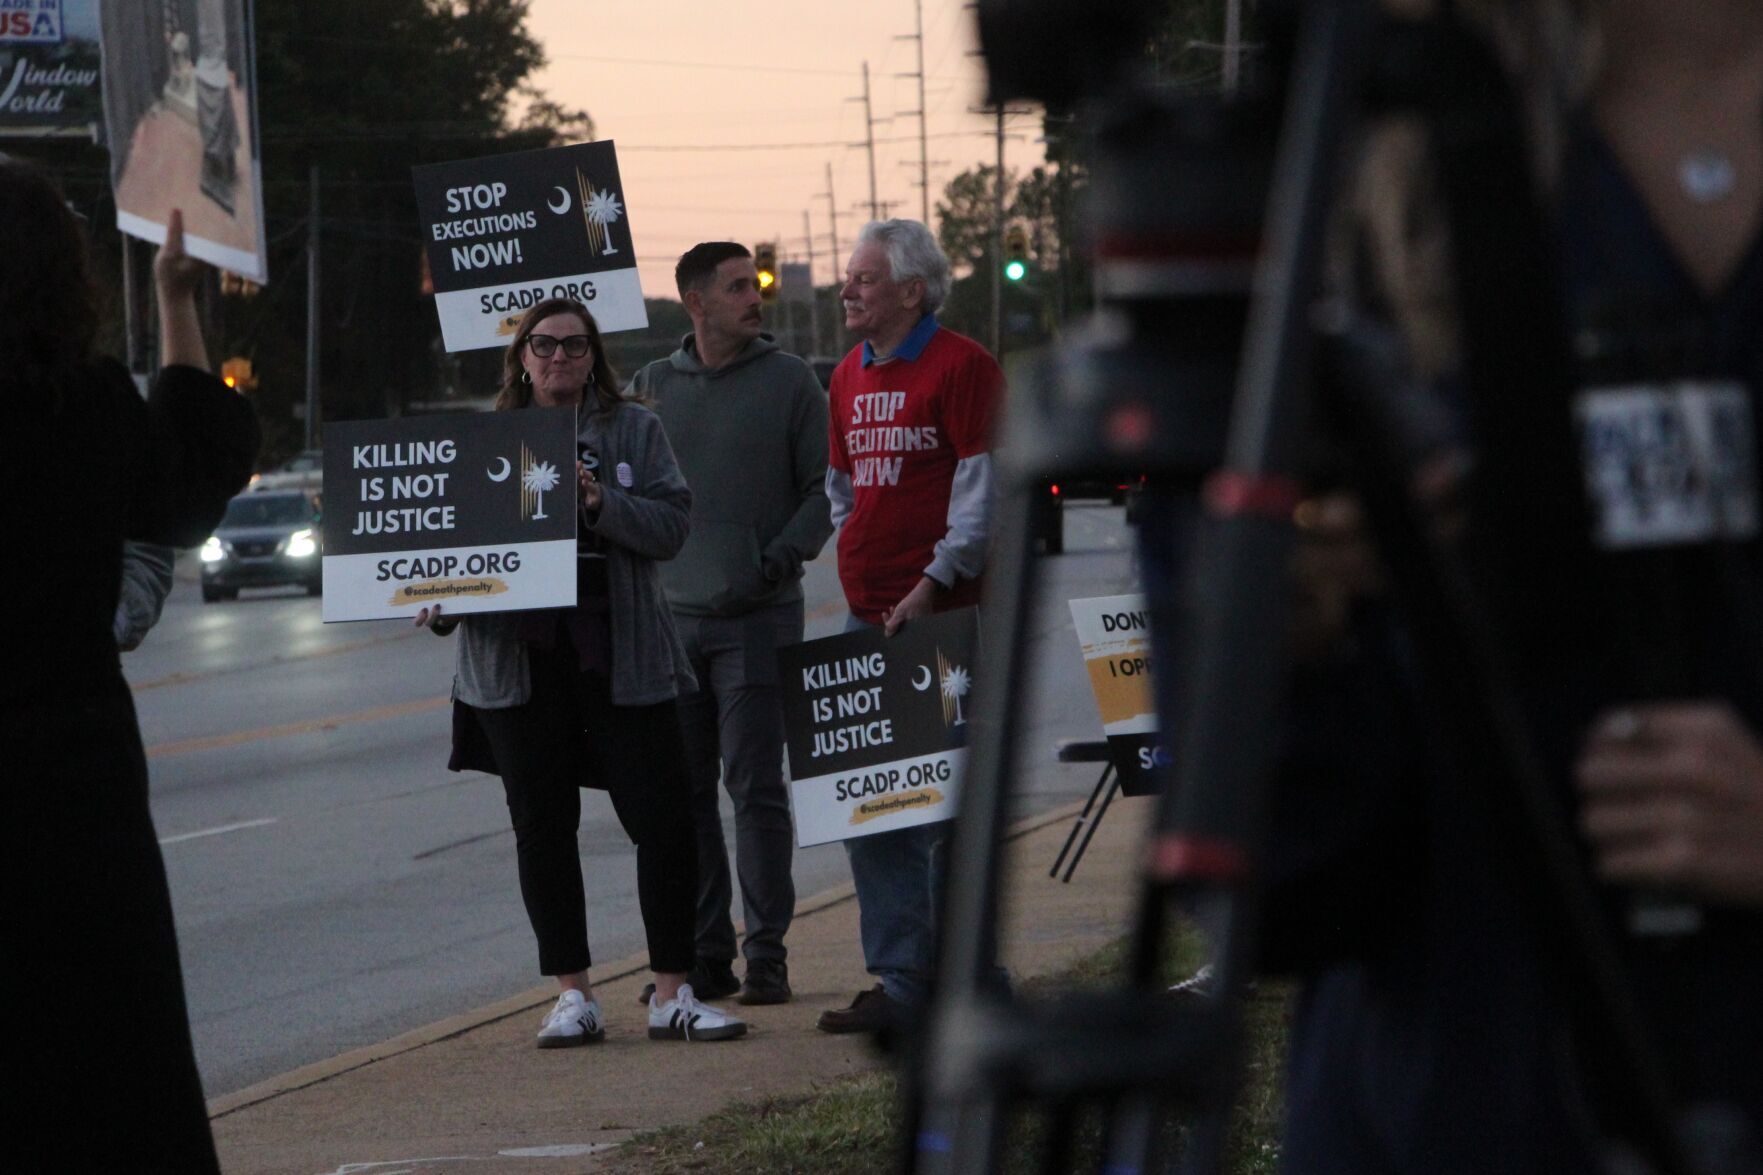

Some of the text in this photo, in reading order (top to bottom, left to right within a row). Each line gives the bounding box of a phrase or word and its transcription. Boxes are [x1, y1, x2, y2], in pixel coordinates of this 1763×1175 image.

[446, 182, 507, 213] STOP
[432, 210, 537, 241] EXECUTIONS
[451, 238, 523, 271] NOW!
[480, 280, 597, 314] SCADPORG
[852, 391, 906, 425] STOP
[353, 439, 457, 469] KILLING
[845, 426, 939, 456] ECUTIONS
[361, 473, 449, 502] IS NOT
[853, 457, 904, 487] NOW
[352, 505, 456, 536] JUSTICE
[376, 551, 522, 582] SCADP.ORG
[403, 581, 493, 598] @scadeathpenalty
[802, 652, 886, 692] KILLING
[1109, 660, 1117, 678] I
[812, 686, 883, 723] IS NOT
[811, 719, 893, 758] JUSTICE
[836, 759, 951, 802] SCADP.ORG
